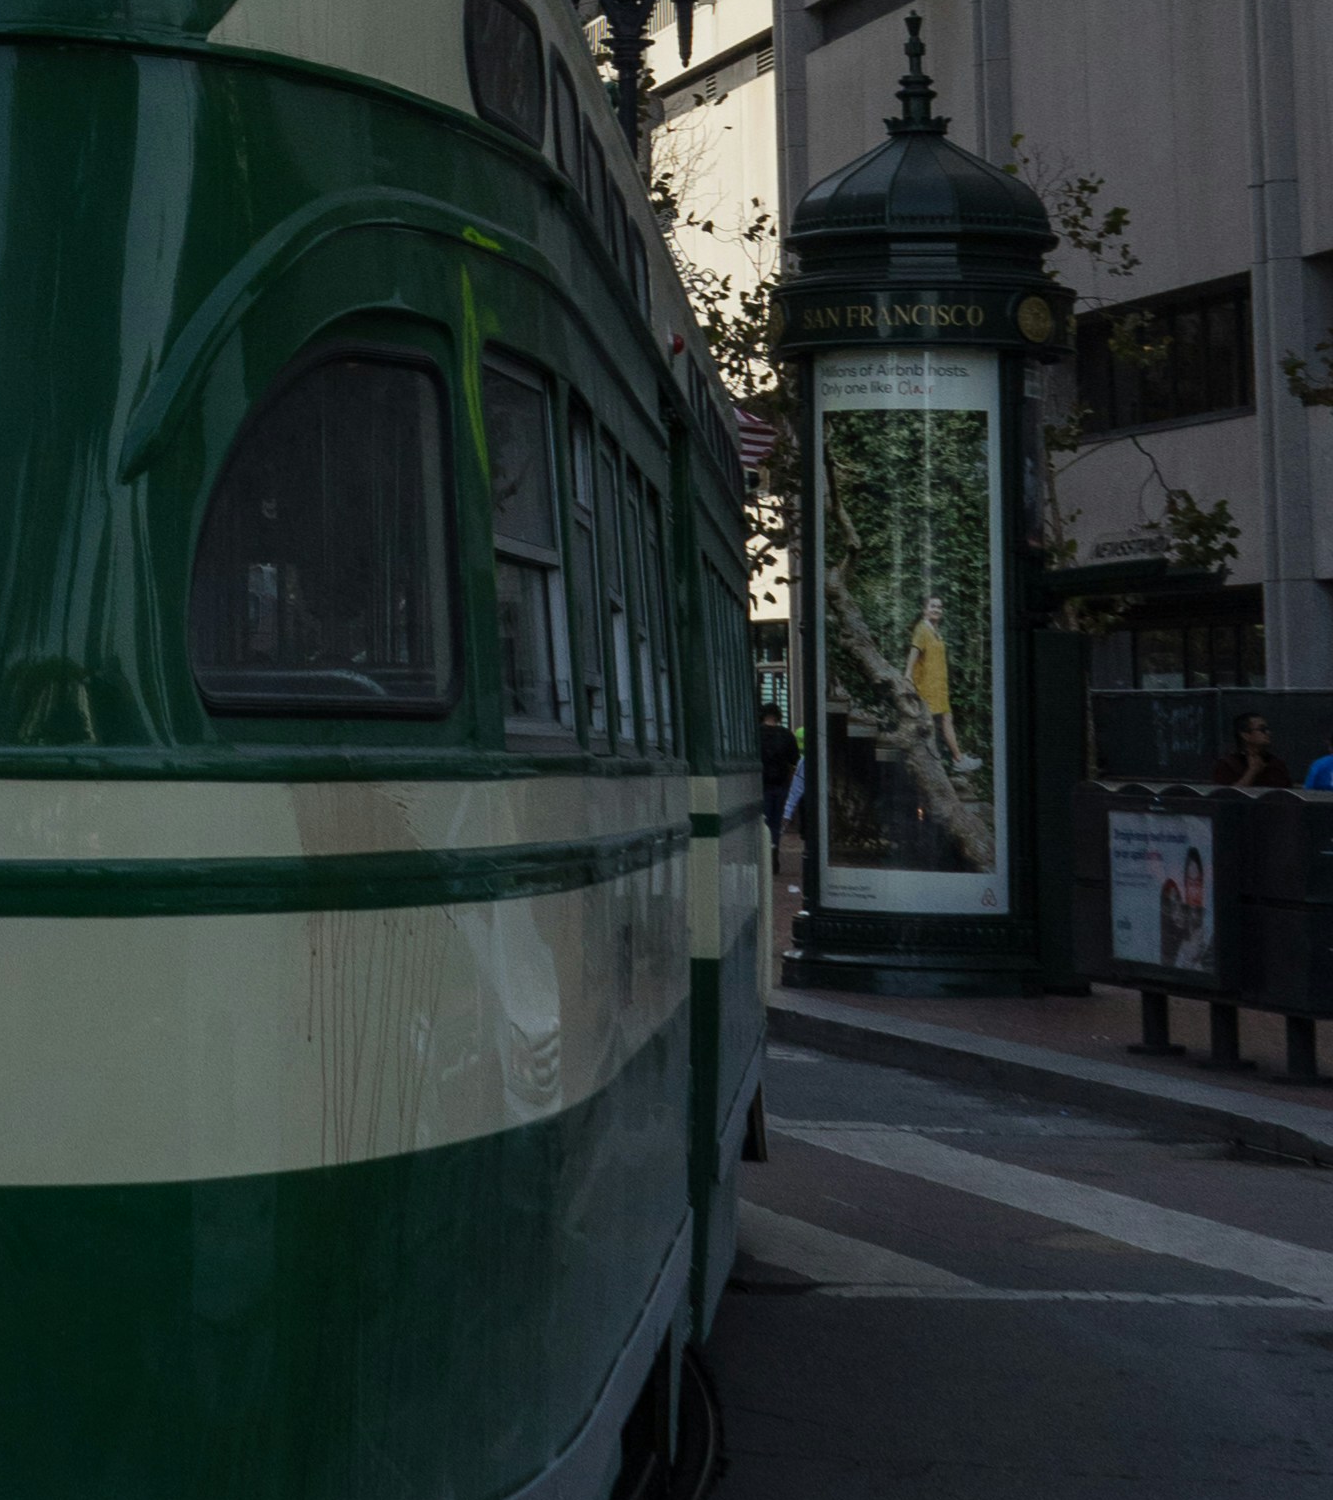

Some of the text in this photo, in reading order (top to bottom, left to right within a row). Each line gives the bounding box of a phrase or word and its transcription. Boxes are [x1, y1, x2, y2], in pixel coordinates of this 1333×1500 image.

[803, 303, 984, 330] SAN FRANCISCO
[859, 363, 872, 377] of
[877, 364, 923, 378] Airbnb
[928, 364, 969, 377] hosts.
[821, 383, 840, 397] Only
[844, 383, 867, 395] one
[871, 382, 893, 395] like
